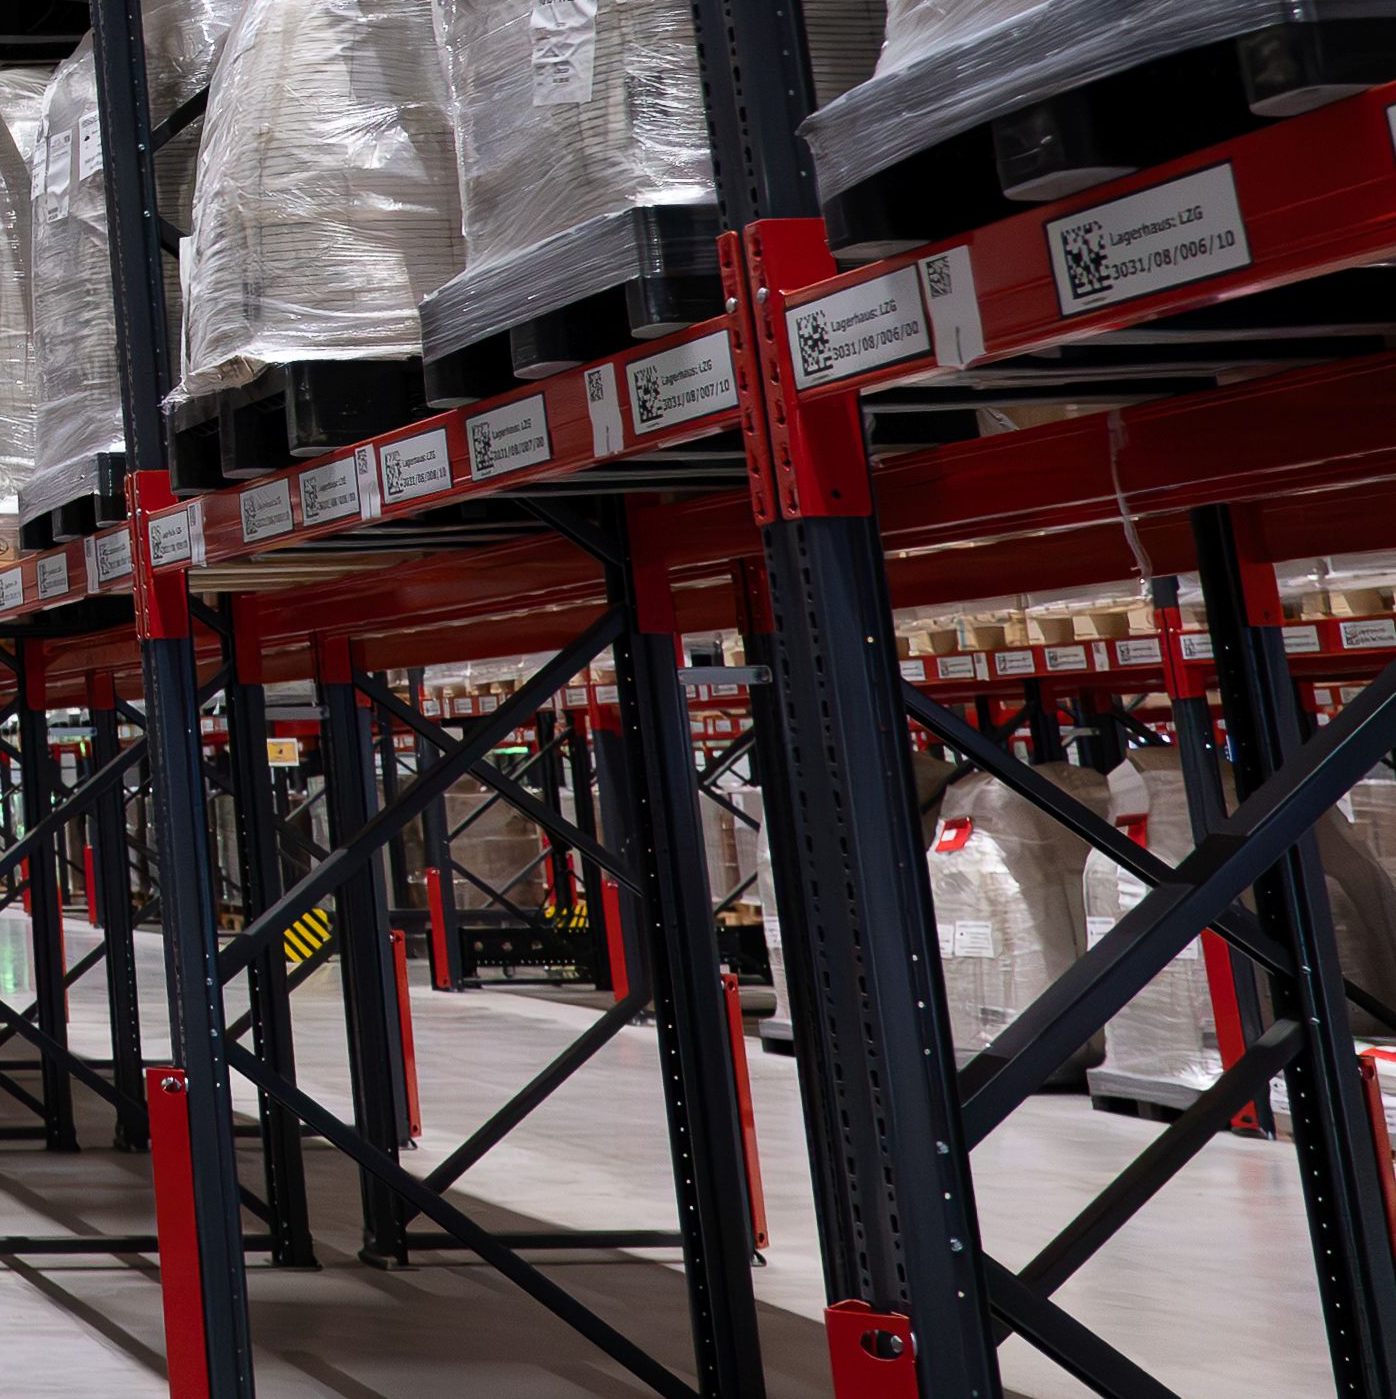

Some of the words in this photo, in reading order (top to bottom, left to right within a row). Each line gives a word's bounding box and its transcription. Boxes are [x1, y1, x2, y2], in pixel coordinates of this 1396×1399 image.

[1110, 216, 1176, 247] Lagerhaus:
[1178, 205, 1204, 226] LZG
[1111, 230, 1235, 280] 3031/08/006/10
[830, 307, 878, 334] Lagerhaus:
[879, 299, 897, 317] LZG
[832, 320, 920, 360] 3031/08/006/00
[660, 366, 698, 387] Lagerhaus:
[699, 359, 713, 372] LZG
[662, 378, 730, 412] 3031/08/007/10
